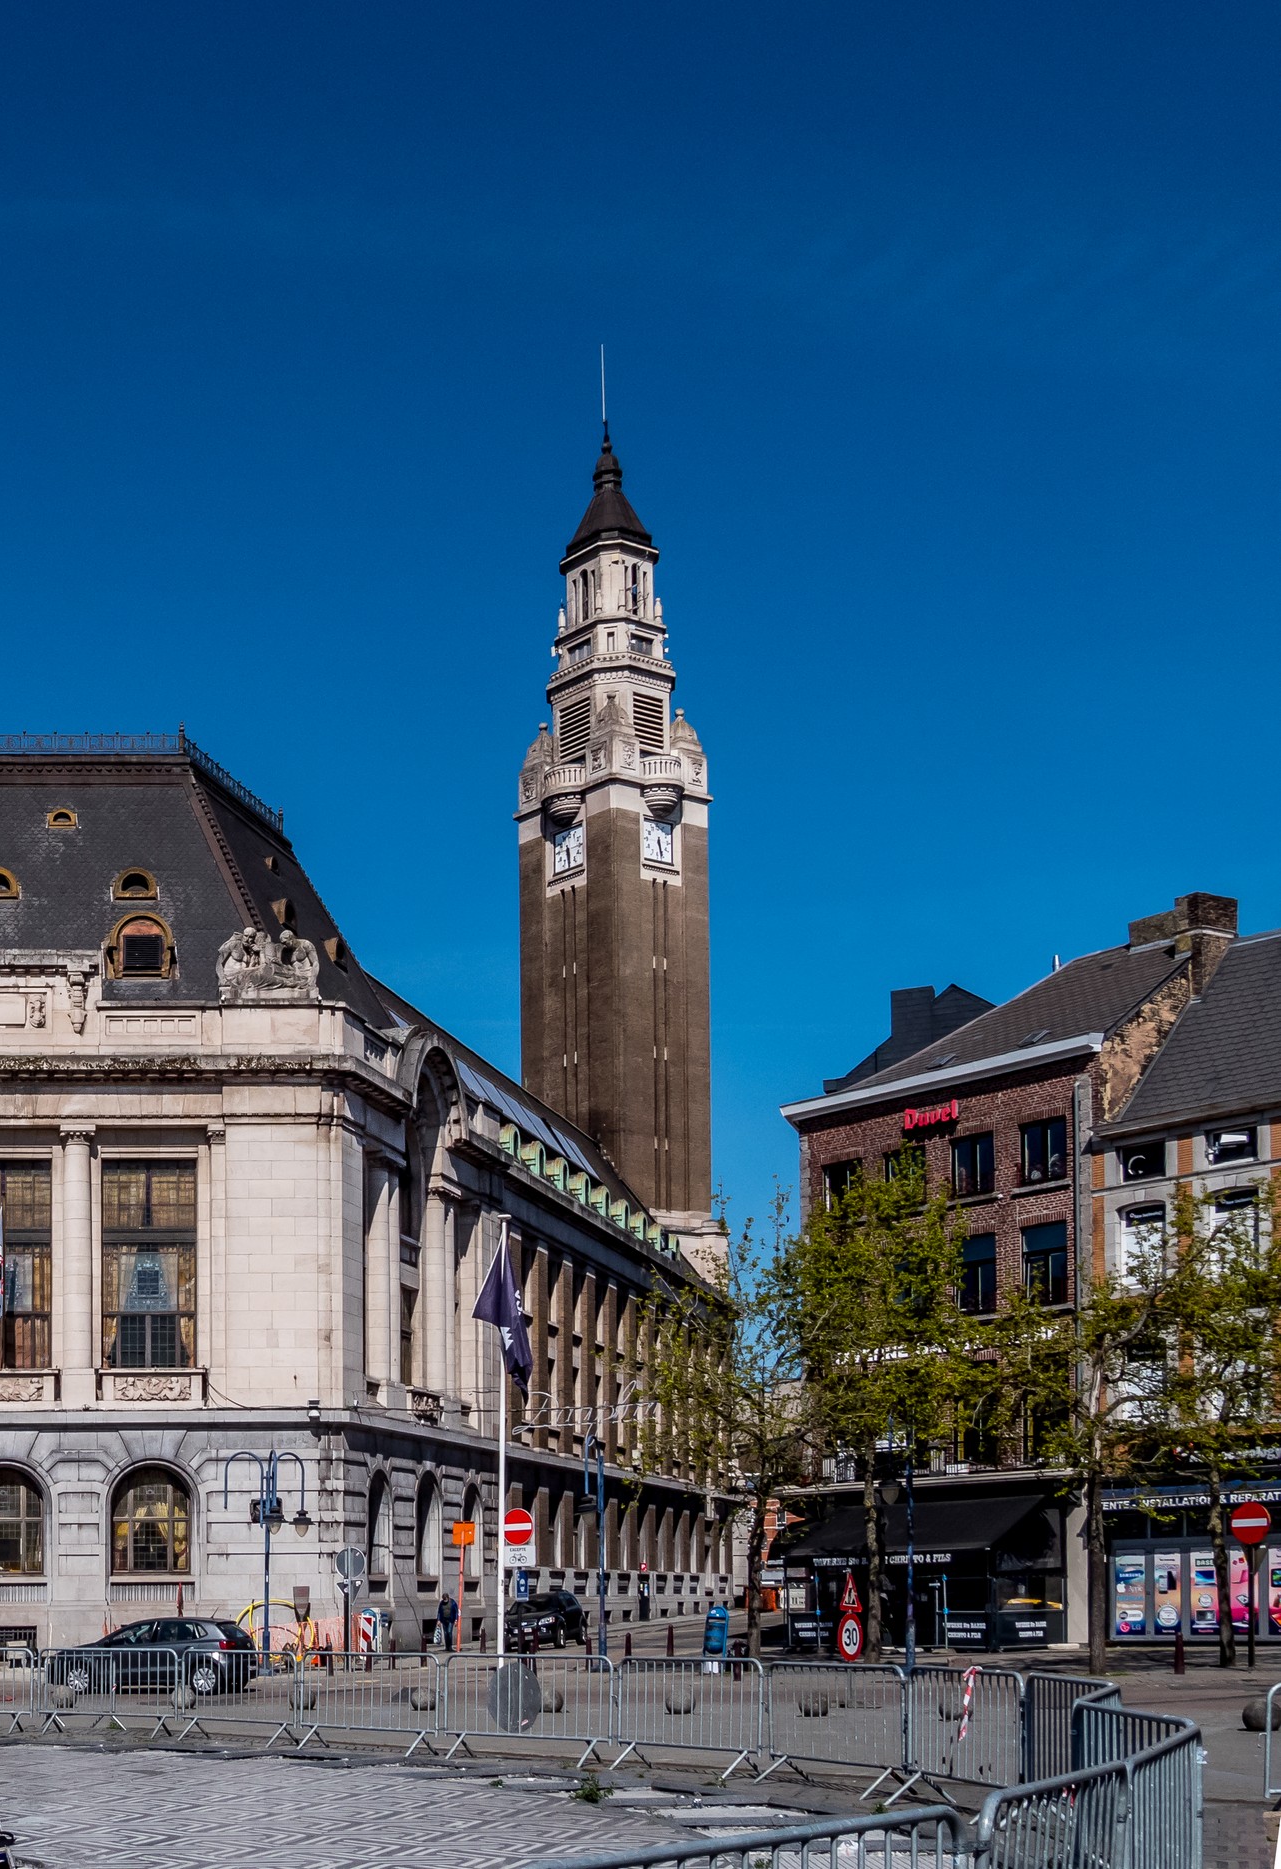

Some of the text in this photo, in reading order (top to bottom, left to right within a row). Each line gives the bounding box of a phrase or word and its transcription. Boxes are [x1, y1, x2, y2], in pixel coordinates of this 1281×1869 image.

[904, 1099, 959, 1130] Duvel
[1101, 1500, 1130, 1510] ENTE
[1139, 1494, 1211, 1508] NSTALLATIO
[889, 1554, 924, 1564] CHRITO
[932, 1553, 952, 1563] FILS
[844, 1627, 858, 1647] 30
